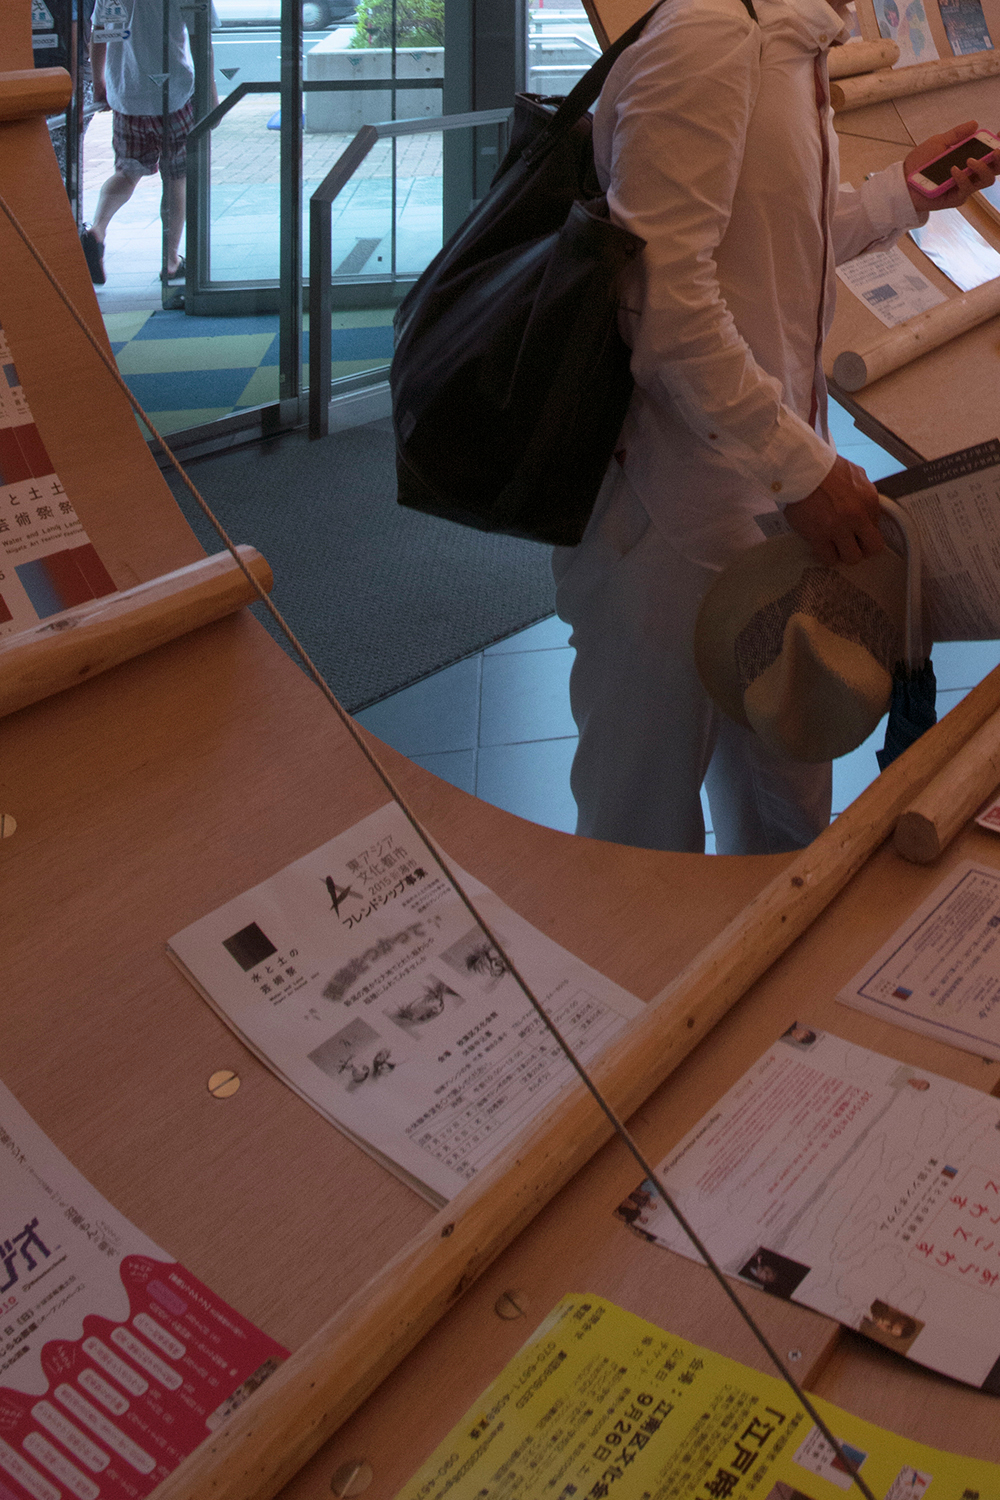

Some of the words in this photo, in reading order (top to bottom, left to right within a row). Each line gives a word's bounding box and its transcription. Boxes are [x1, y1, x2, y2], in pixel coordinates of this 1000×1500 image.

[343, 833, 401, 873] 東アジア
[353, 845, 411, 885] 文化都市
[340, 865, 430, 930] フレンドシップ事業
[248, 946, 302, 985] 水と土の
[257, 965, 299, 995] 芸術祭
[589, 1390, 656, 1463] 9月26日
